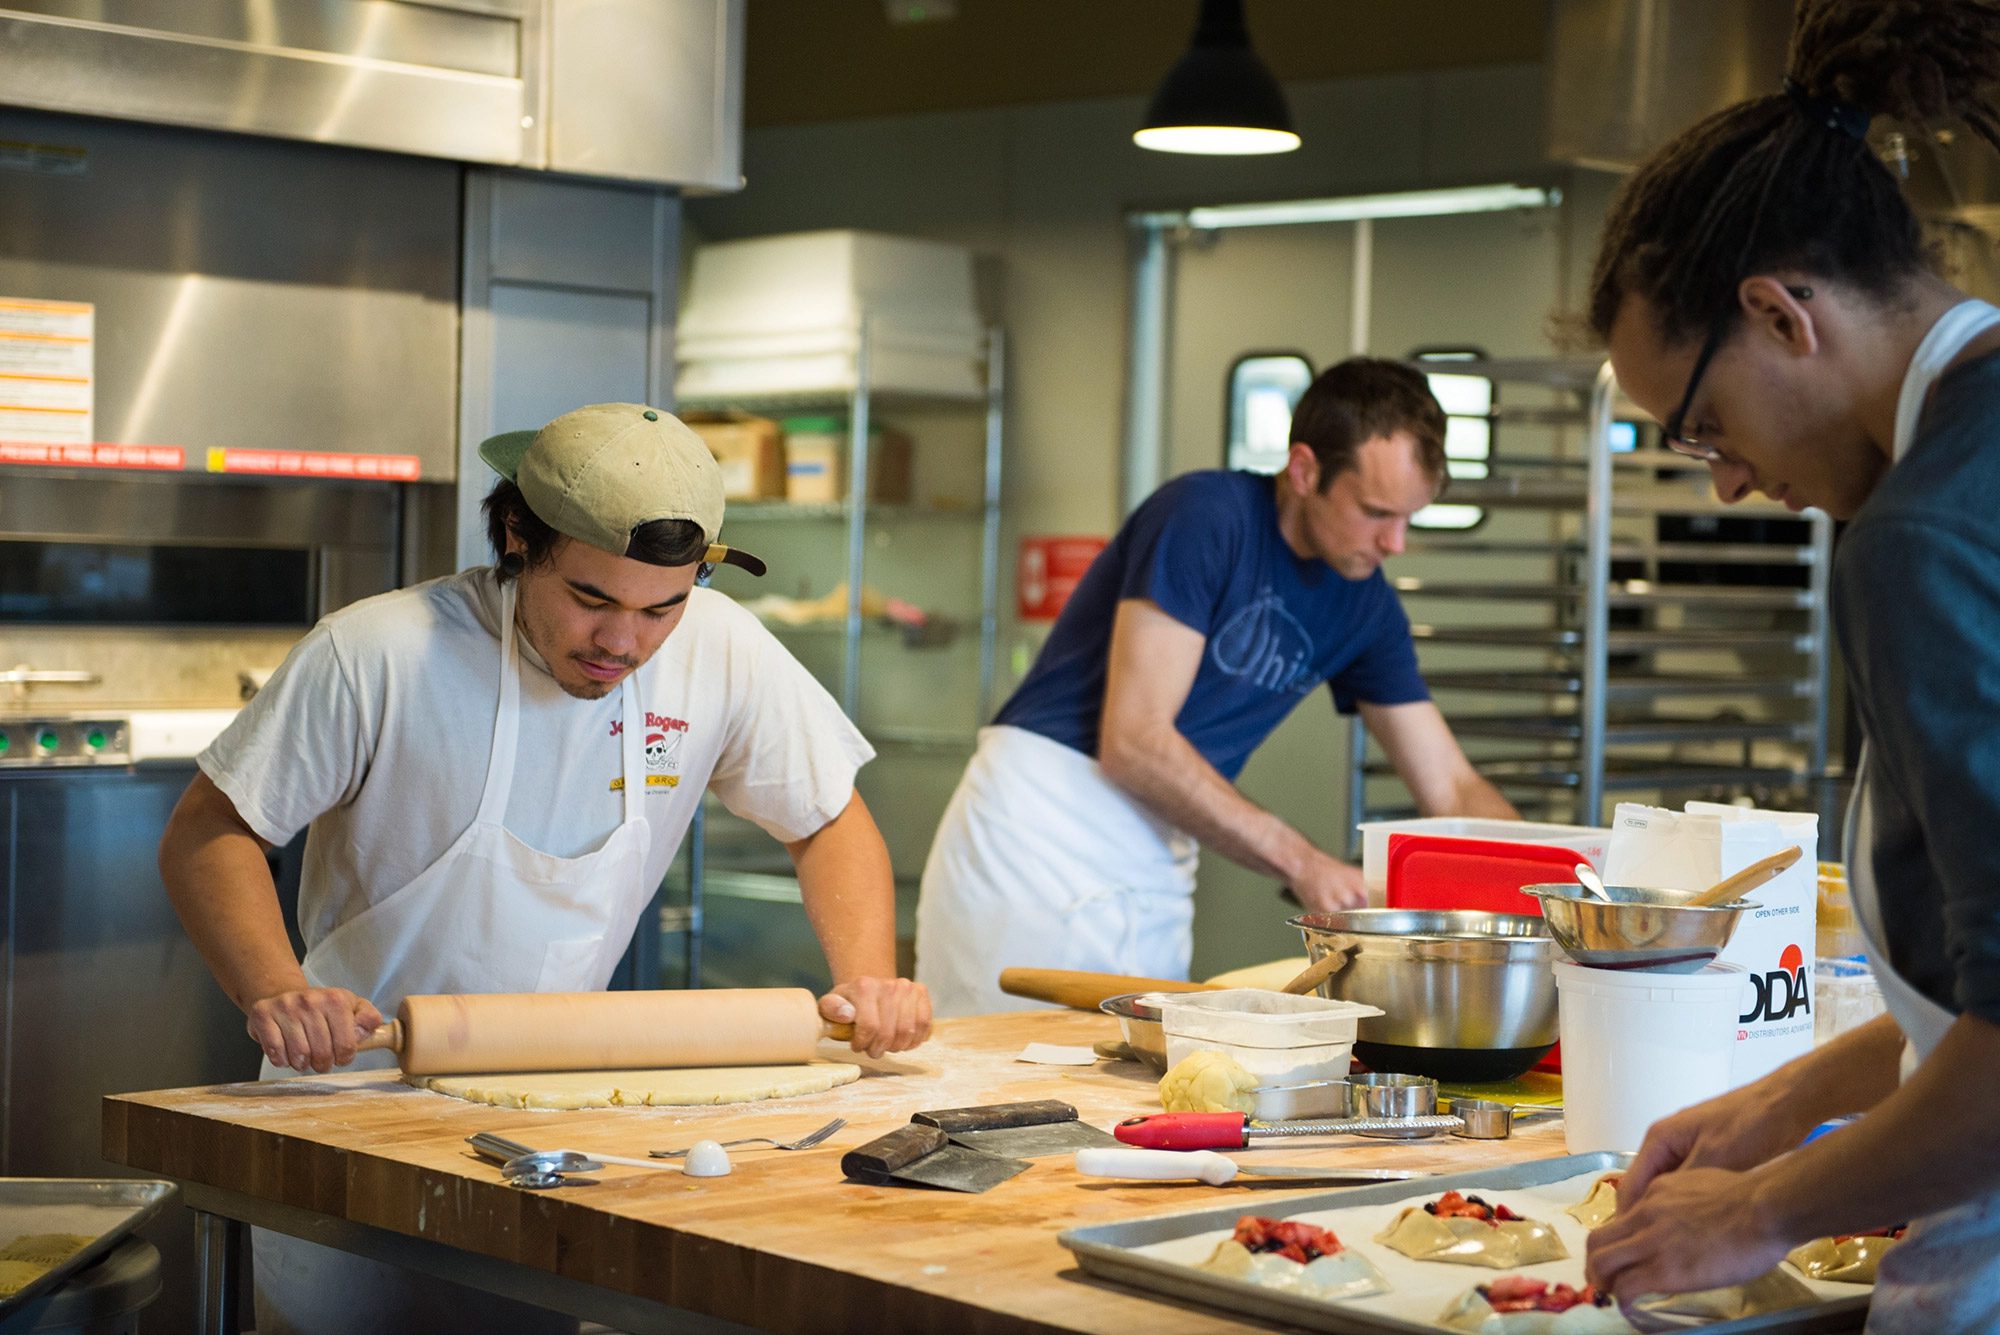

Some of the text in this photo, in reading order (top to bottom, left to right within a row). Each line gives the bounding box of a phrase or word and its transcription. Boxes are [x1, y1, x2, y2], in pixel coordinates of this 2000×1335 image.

[1755, 905, 1800, 919] OPEN OTHER SIDE
[1749, 1026, 1790, 1040] DISTRIBUTORS
